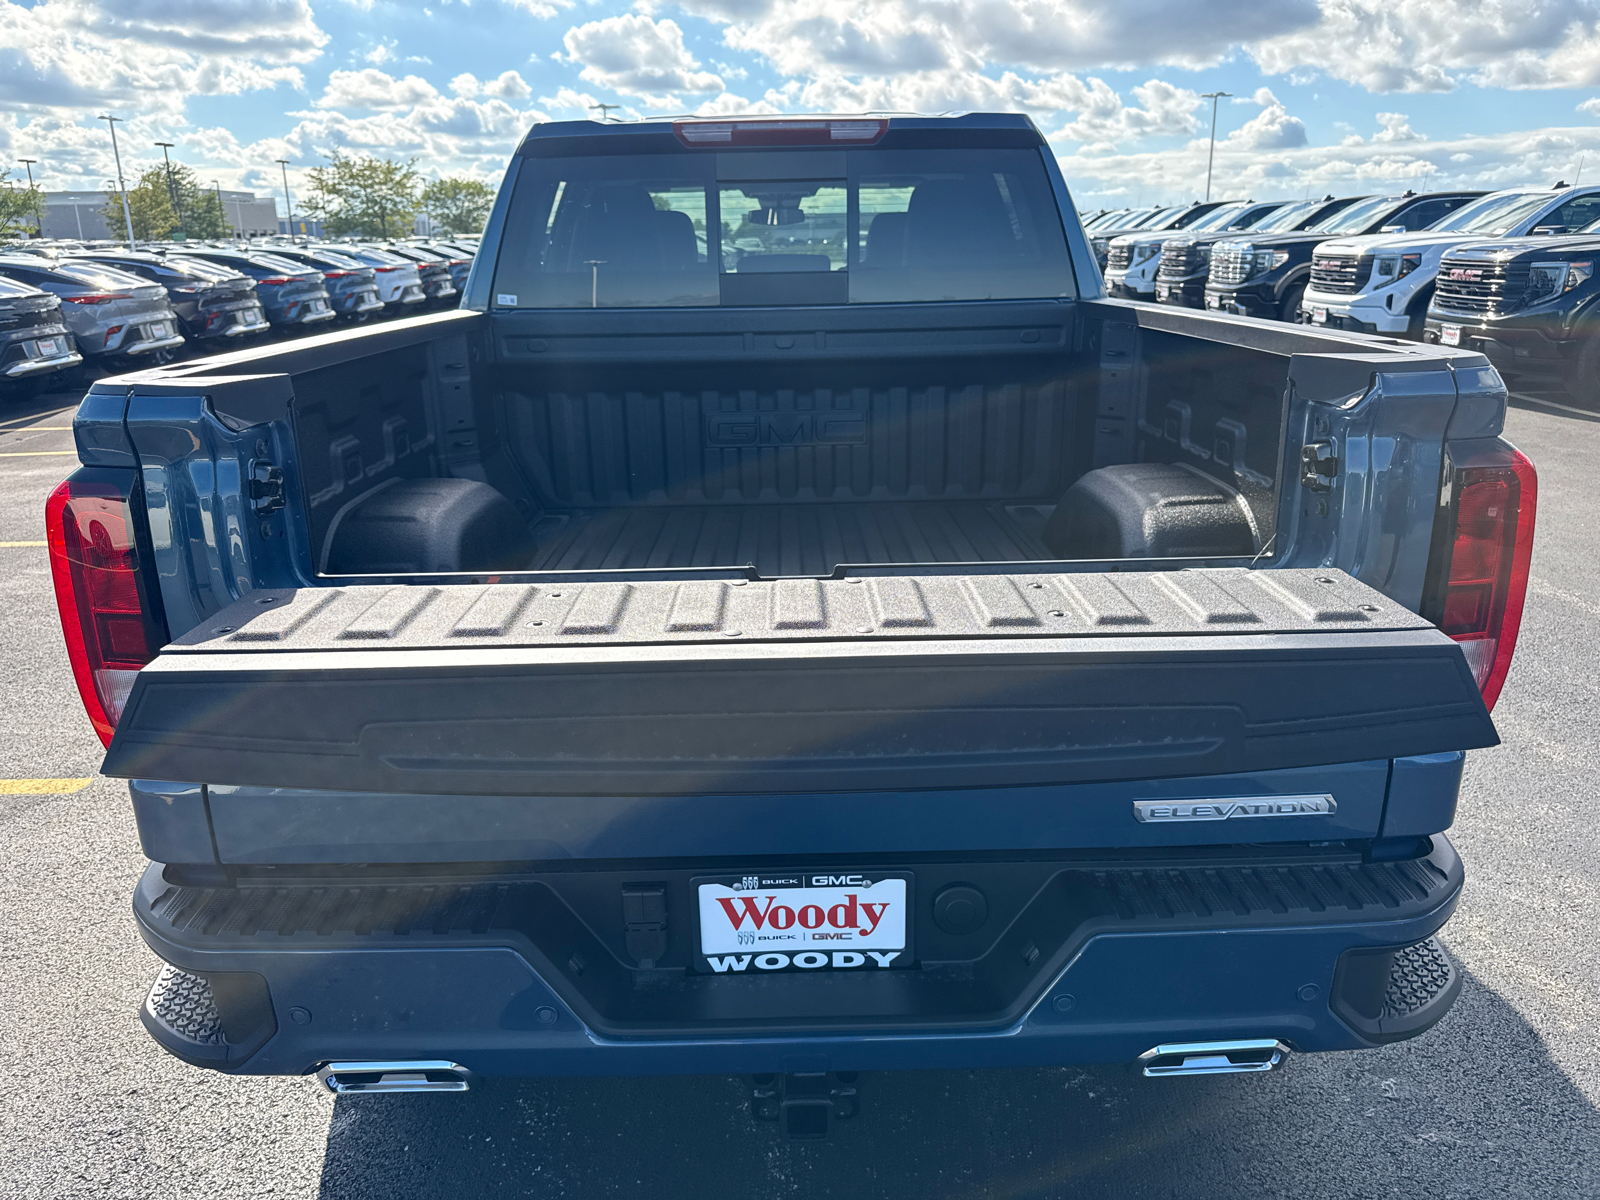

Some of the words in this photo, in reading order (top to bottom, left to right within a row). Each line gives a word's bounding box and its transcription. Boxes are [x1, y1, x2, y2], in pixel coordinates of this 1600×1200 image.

[1450, 268, 1483, 281] GMC
[708, 411, 866, 445] GMC
[1150, 800, 1322, 818] ELEVATION
[811, 875, 863, 886] GMC
[715, 894, 890, 937] Woody
[812, 932, 853, 941] GMC
[706, 951, 902, 973] WOODY
